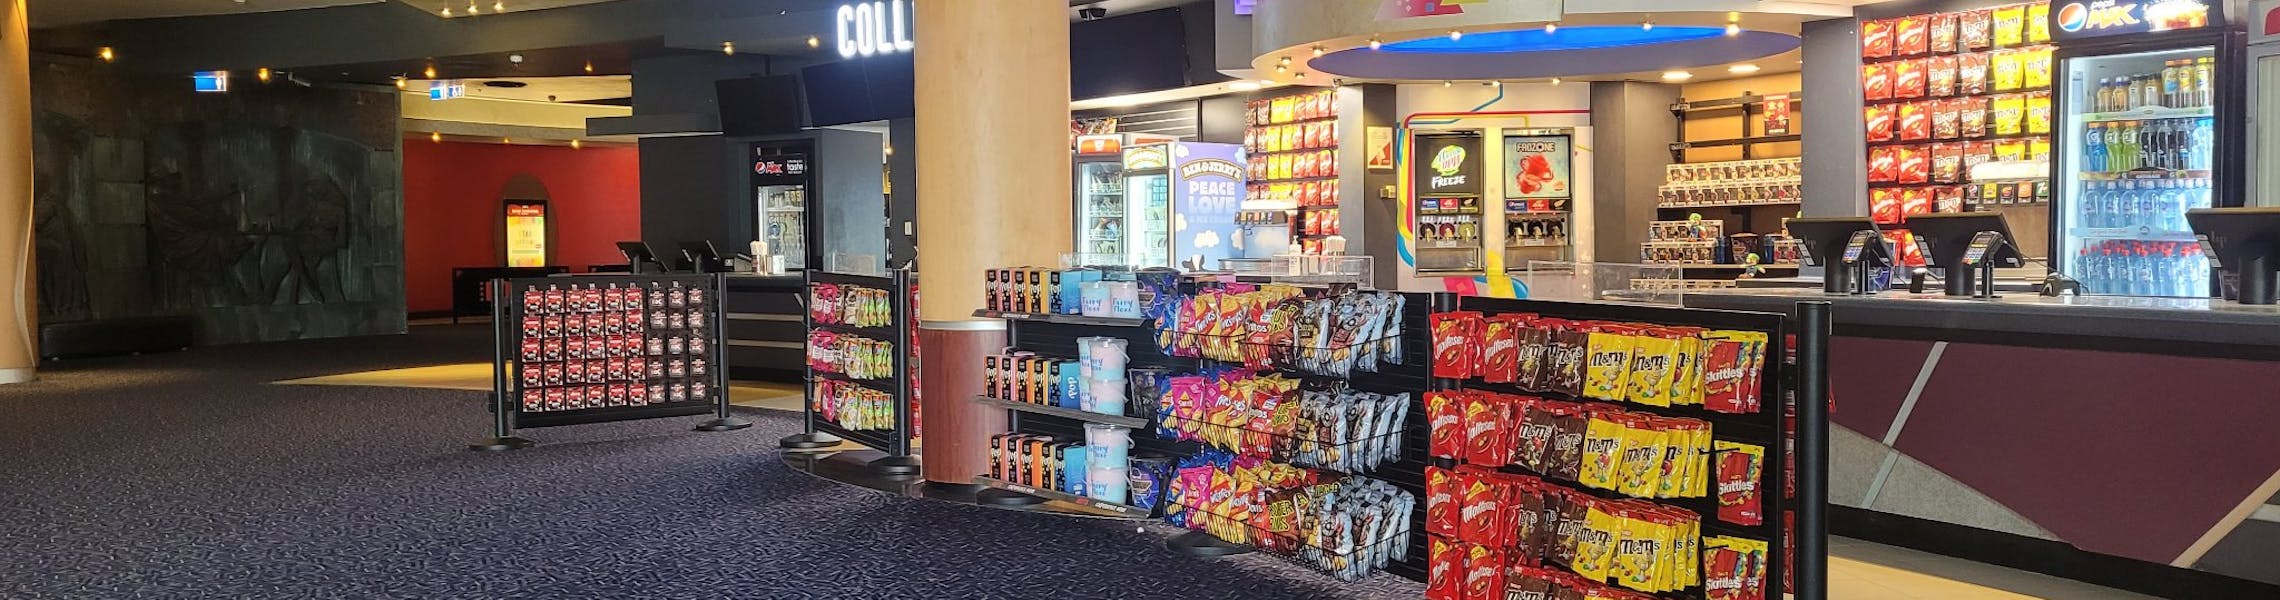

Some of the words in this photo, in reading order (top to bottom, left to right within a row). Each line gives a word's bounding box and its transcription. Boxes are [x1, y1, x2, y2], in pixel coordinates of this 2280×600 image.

[837, 0, 914, 58] COLL
[1188, 181, 1236, 196] PEACE
[1431, 175, 1467, 189] FREEZE
[1187, 195, 1236, 213] LOVE
[1705, 367, 1744, 384] Skittles
[1718, 479, 1756, 496] Skittles
[1620, 538, 1661, 556] m&m's
[1704, 575, 1744, 592] Skittles
